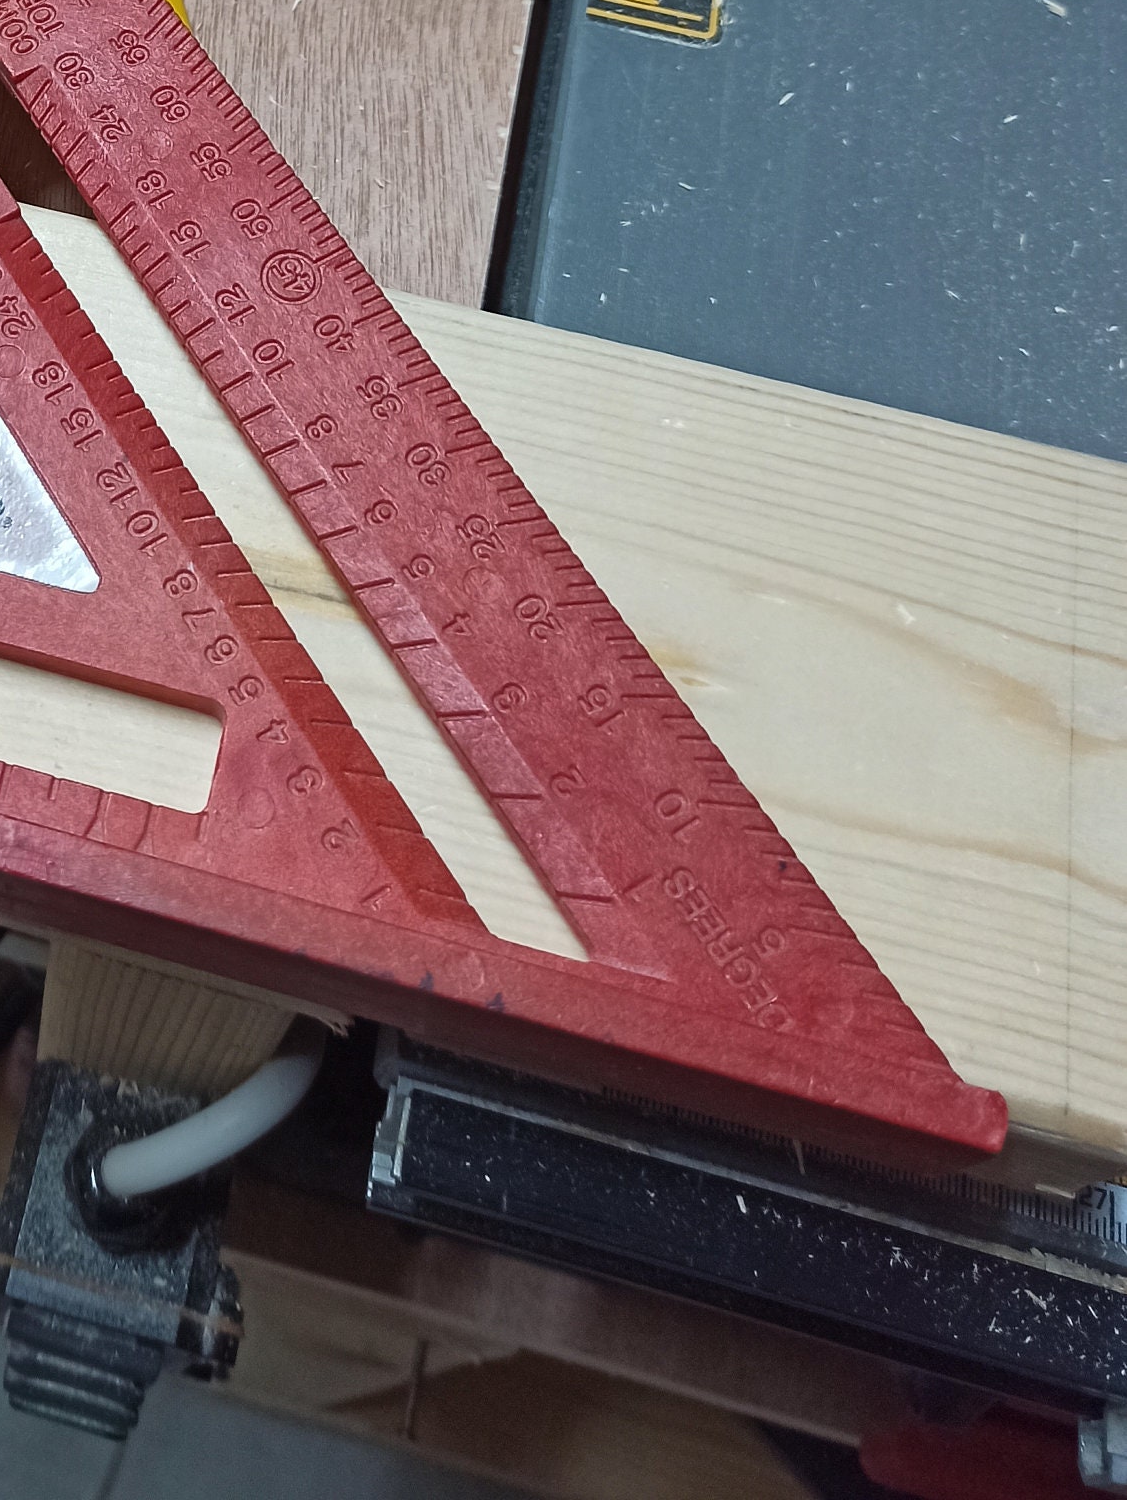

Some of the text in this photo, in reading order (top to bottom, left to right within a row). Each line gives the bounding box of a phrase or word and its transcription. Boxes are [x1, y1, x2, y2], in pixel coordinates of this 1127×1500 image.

[32, 360, 74, 406] 18
[60, 407, 104, 452] 15
[97, 461, 140, 510] 12
[126, 509, 168, 557] 10
[163, 568, 198, 599] 8
[181, 608, 216, 632] 7
[204, 635, 239, 665] 6
[228, 674, 266, 706] 5
[256, 718, 289, 745] 4
[286, 764, 323, 798] 3
[321, 817, 360, 853] 2
[54, 51, 94, 90] 30
[90, 104, 133, 143] 24
[135, 169, 174, 210] 18
[169, 220, 211, 260] 15
[215, 282, 256, 326] 12
[253, 339, 295, 381] 10
[305, 414, 338, 441] 8
[331, 460, 367, 484] 7
[364, 499, 398, 525] 6
[402, 554, 436, 580] 5
[441, 612, 472, 636] 4
[492, 682, 528, 714] 3
[550, 764, 587, 799] 2
[109, 29, 150, 67] 65
[150, 85, 191, 123] 60
[190, 142, 232, 182] 55
[231, 198, 273, 240] 50
[270, 255, 317, 295] 45
[313, 314, 354, 354] 40
[356, 375, 404, 420] 35
[405, 442, 451, 486] 30
[456, 513, 506, 561] 25
[514, 594, 564, 643] 20
[577, 684, 625, 735] 15
[664, 866, 795, 1032] DEGREES
